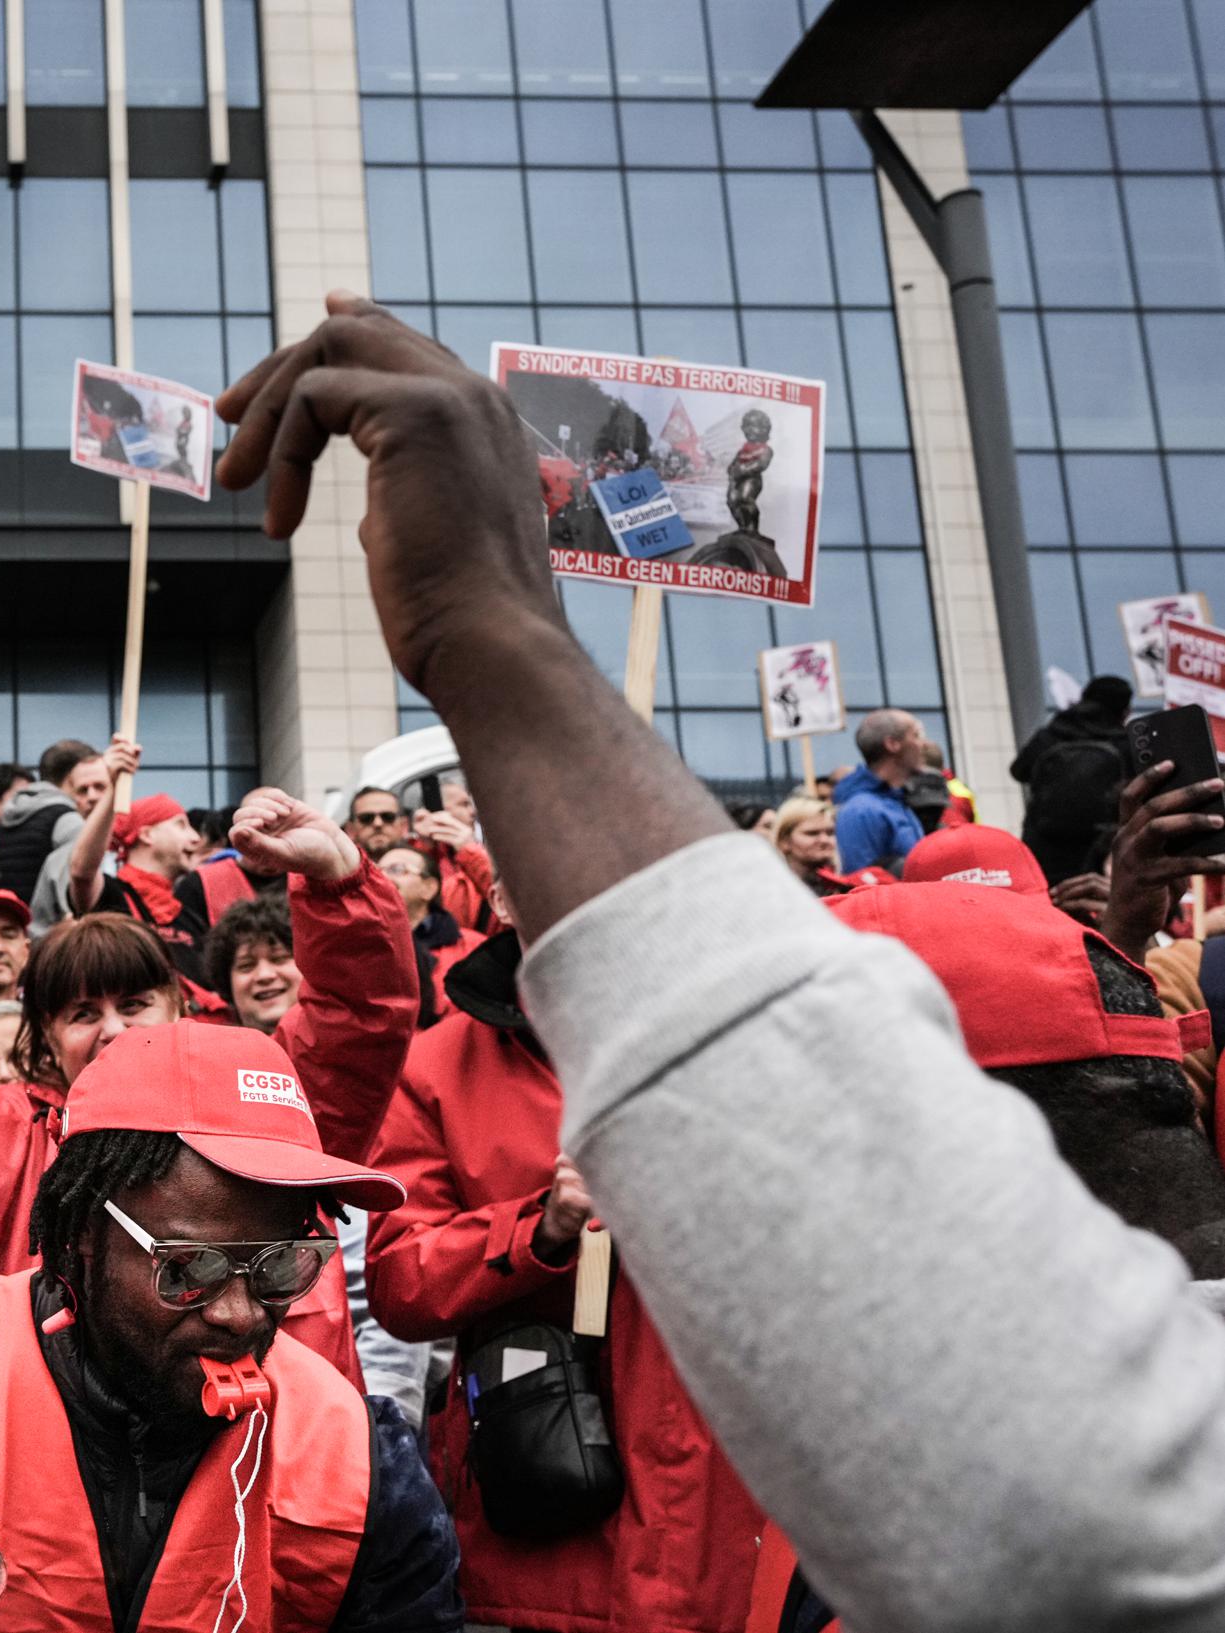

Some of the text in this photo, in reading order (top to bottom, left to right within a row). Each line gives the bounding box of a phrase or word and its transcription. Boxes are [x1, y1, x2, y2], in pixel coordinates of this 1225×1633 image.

[517, 352, 801, 403] SYNDICALISTE PAS TERRORISTE !!!
[618, 484, 648, 505] LOI
[636, 526, 668, 547] WET
[549, 549, 789, 599] DICALIST GEEN TERRORIST !!!
[242, 1073, 292, 1091] CGSP
[242, 1092, 268, 1101] FGTB
